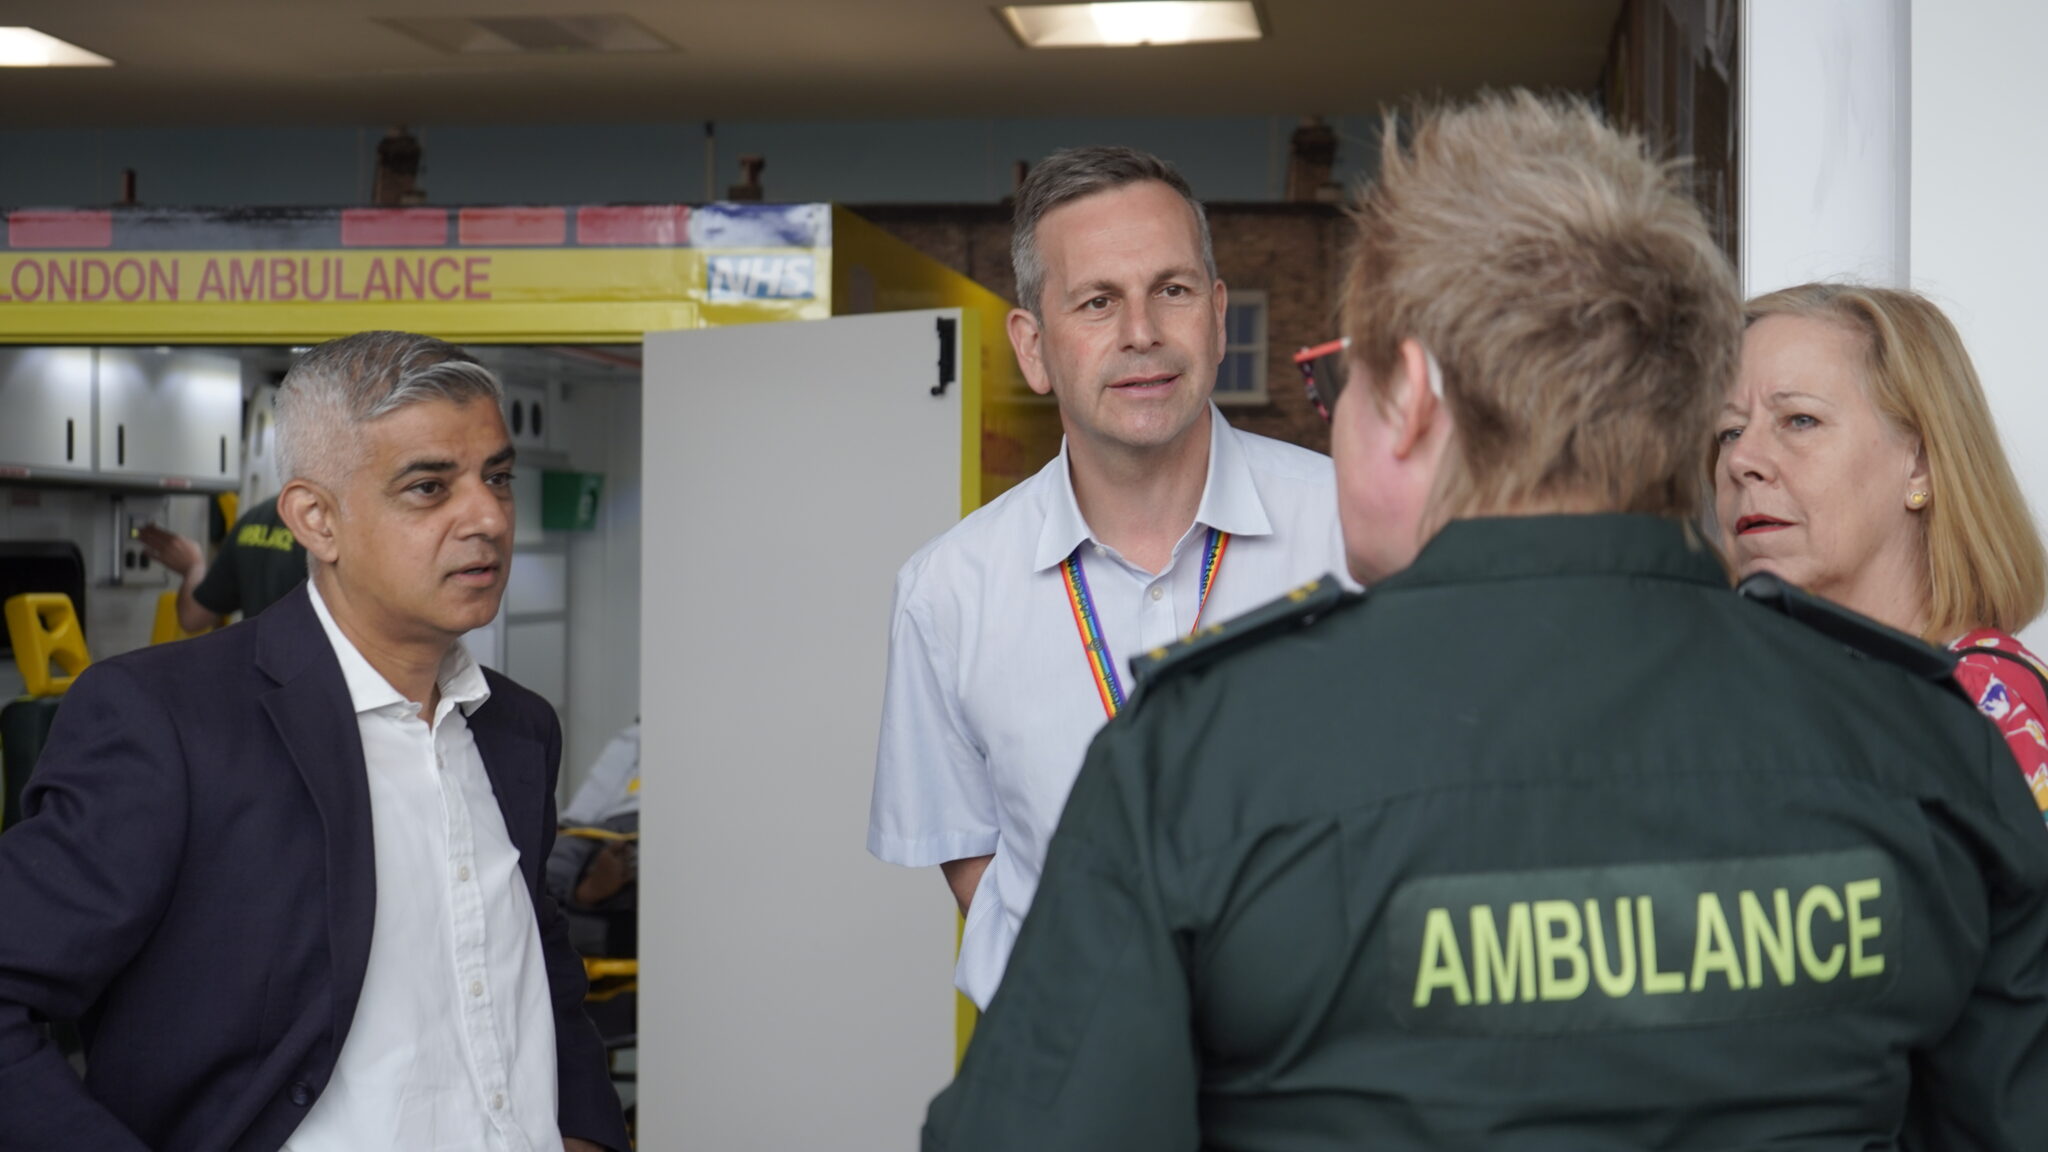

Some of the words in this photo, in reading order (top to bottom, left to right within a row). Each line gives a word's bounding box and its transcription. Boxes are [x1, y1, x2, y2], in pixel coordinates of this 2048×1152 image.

[196, 257, 492, 301] AMBULANCE
[709, 257, 814, 298] NHS
[1413, 878, 1886, 1007] AMBULANCE
